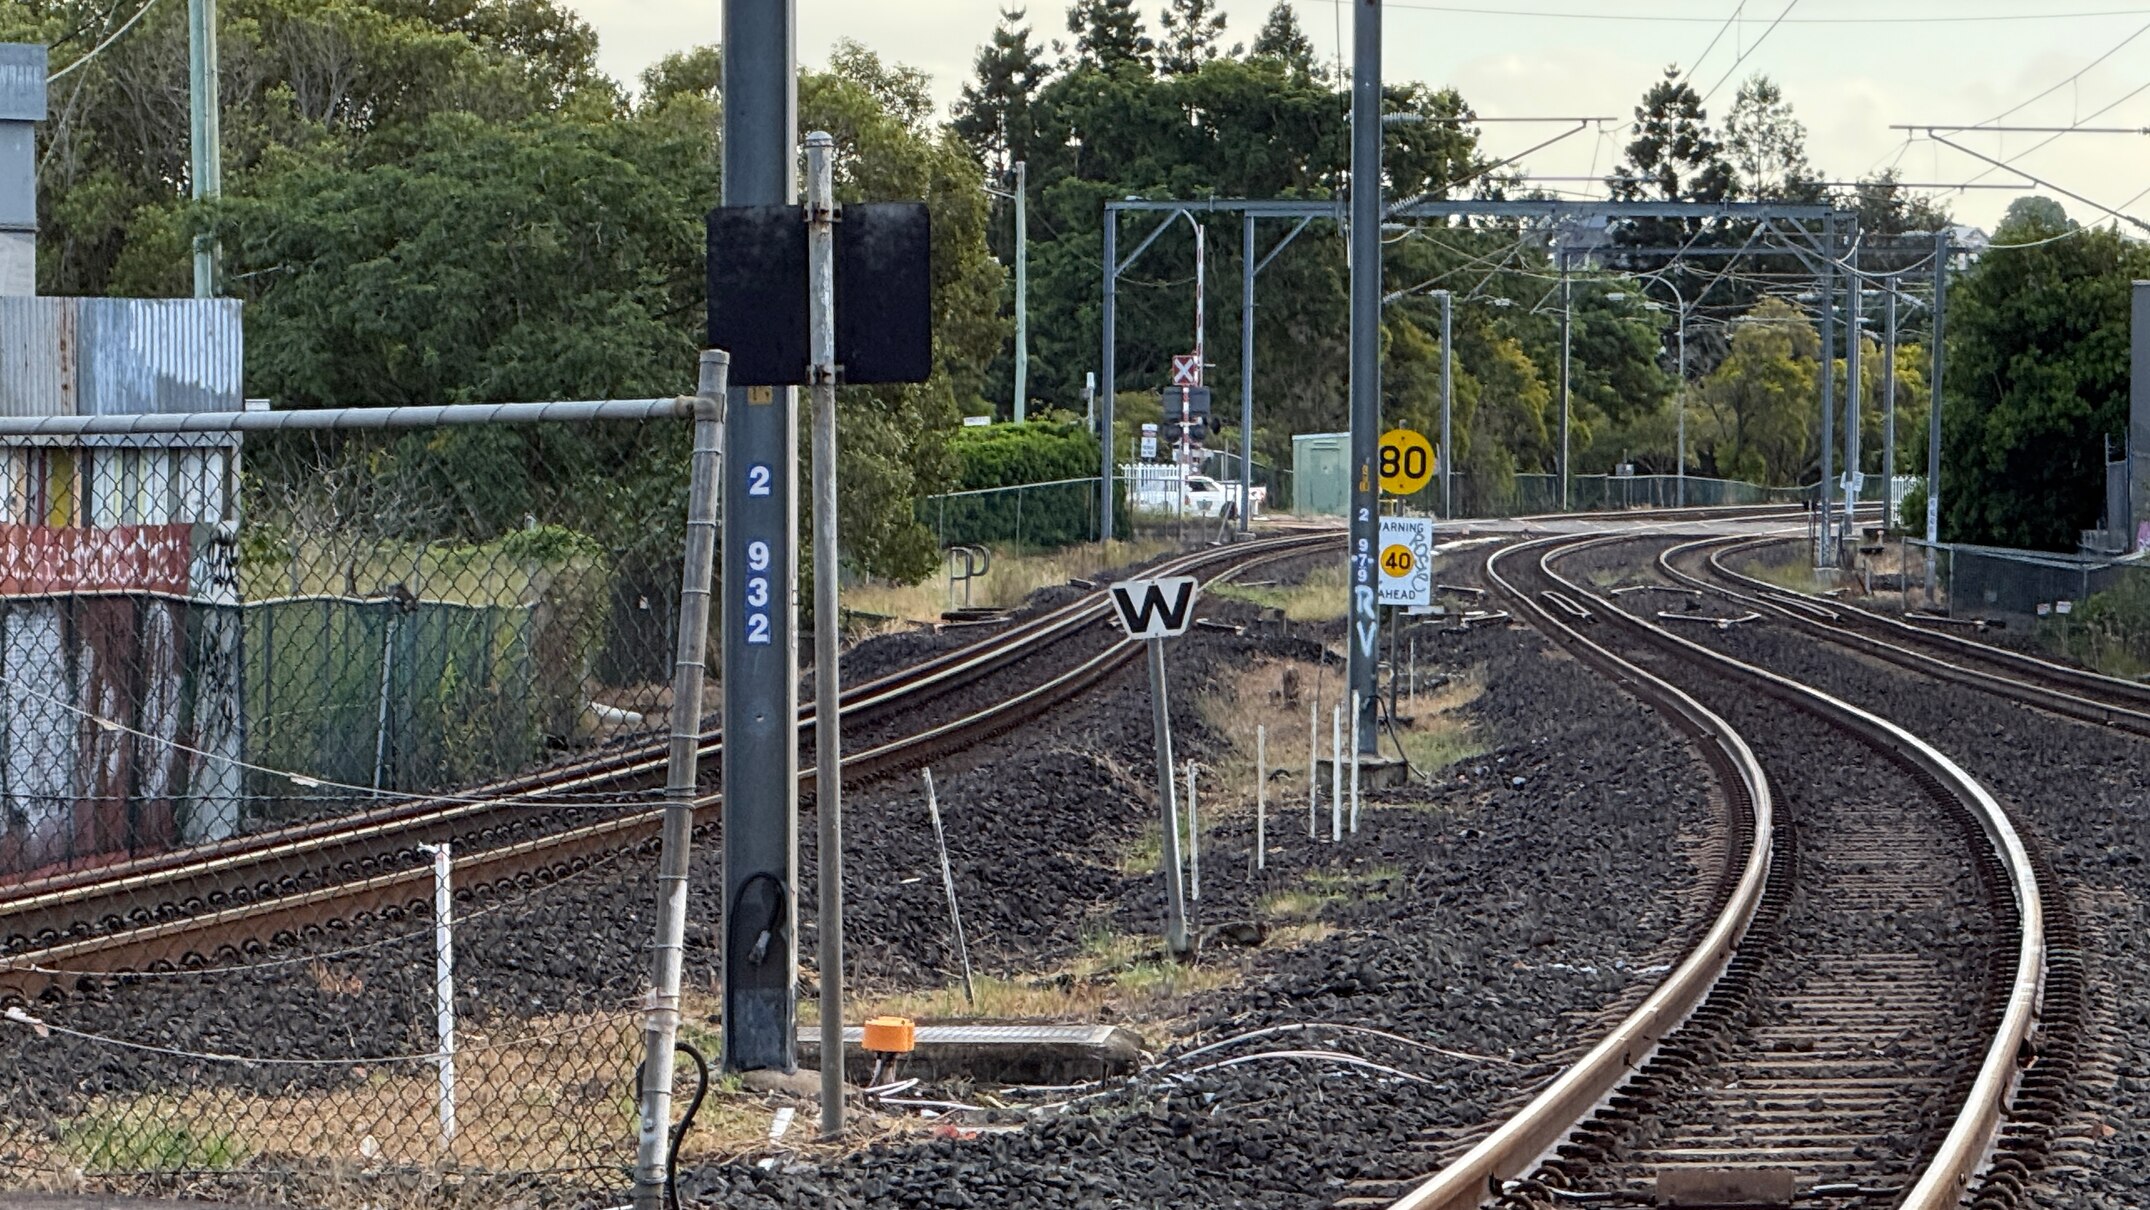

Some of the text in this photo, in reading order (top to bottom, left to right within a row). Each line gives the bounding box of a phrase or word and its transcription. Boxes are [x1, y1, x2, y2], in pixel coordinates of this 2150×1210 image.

[1380, 445, 1426, 479] 80
[750, 465, 770, 495] 2
[1358, 507, 1369, 522] 2
[1379, 521, 1424, 534] ARNING
[1385, 551, 1411, 570] 40
[1111, 581, 1194, 633] W
